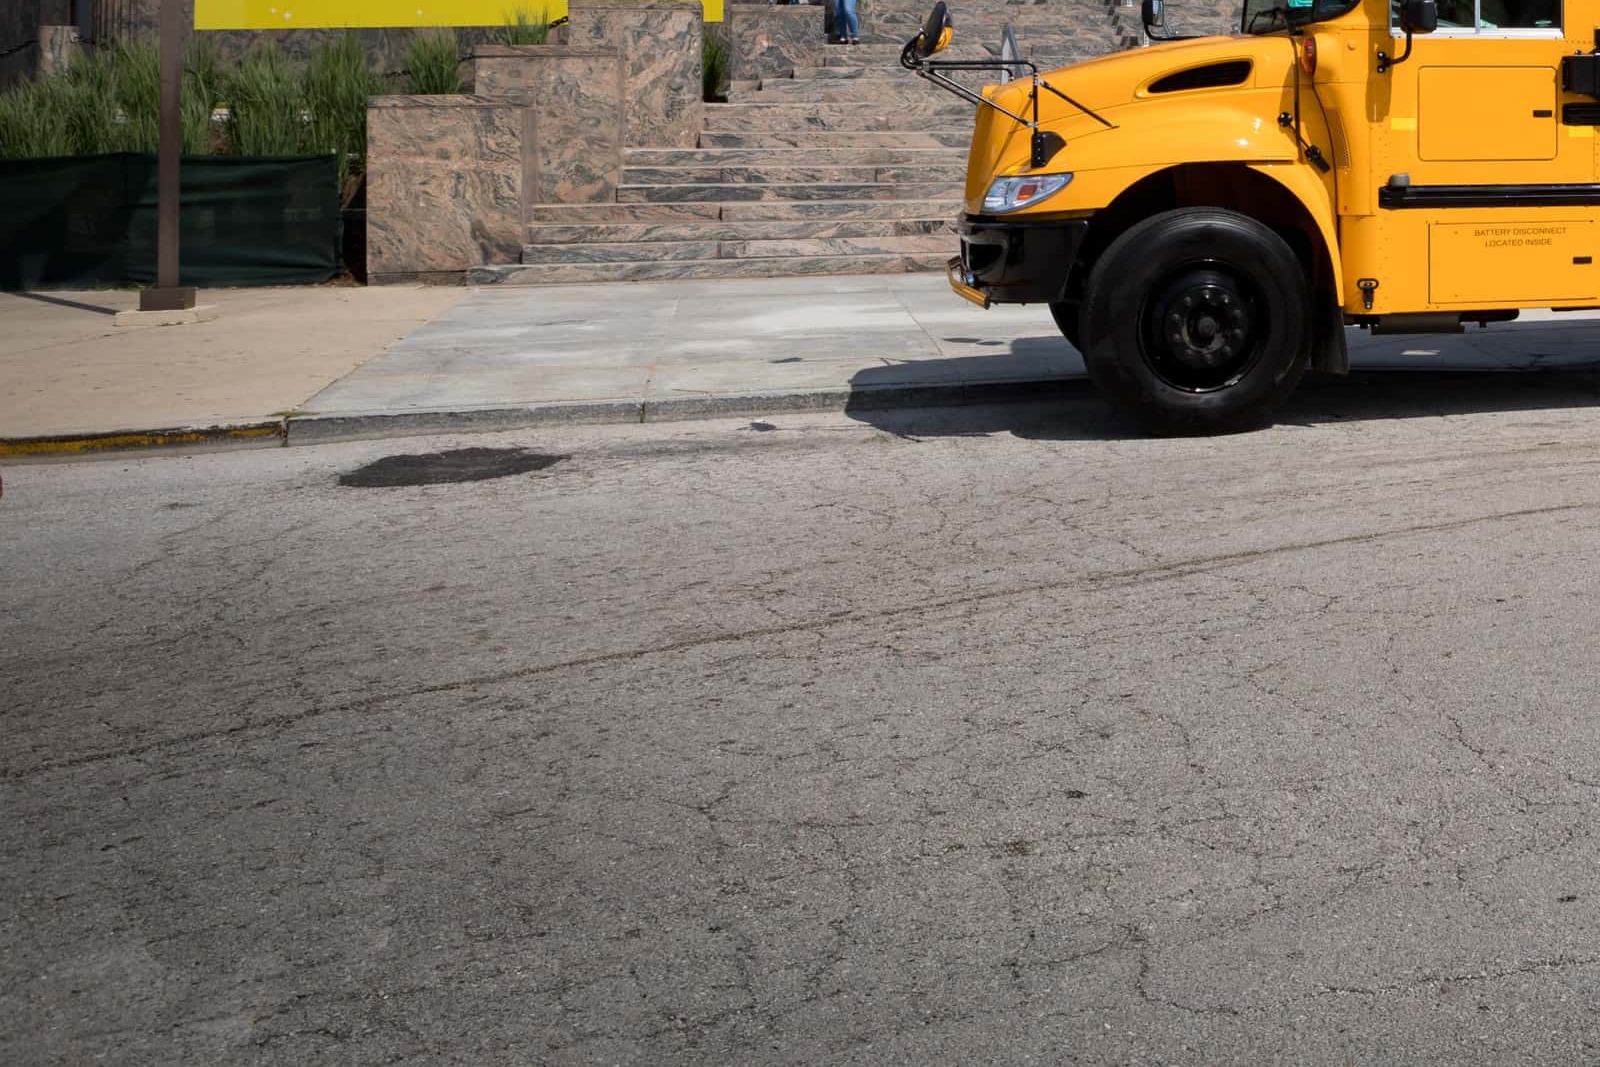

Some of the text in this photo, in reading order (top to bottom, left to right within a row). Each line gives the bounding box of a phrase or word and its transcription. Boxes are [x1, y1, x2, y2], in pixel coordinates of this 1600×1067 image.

[1473, 226, 1567, 237] BATTERY DISCONNECT
[1484, 237, 1553, 247] LOCATED INSIDE
